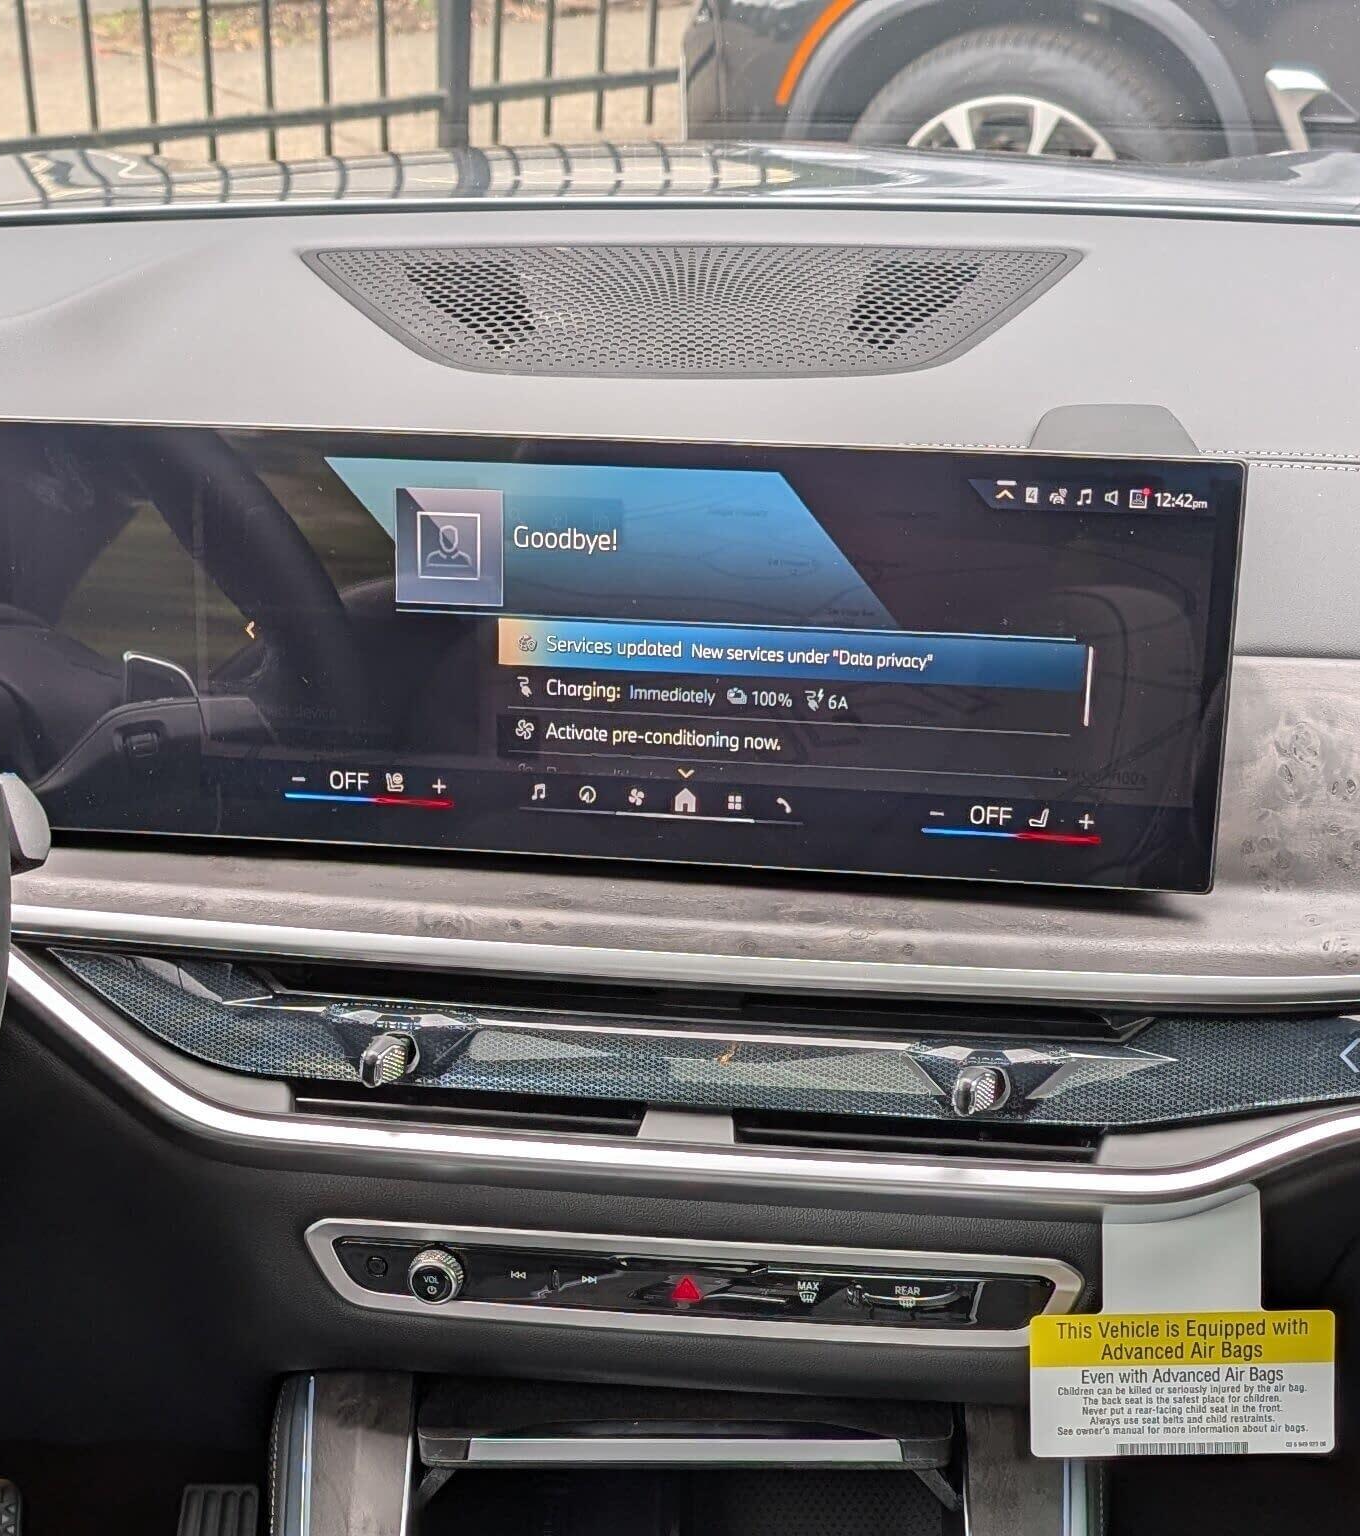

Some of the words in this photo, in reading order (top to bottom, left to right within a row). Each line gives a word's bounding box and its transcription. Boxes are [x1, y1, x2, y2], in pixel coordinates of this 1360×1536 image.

[513, 525, 619, 555] Goodbye!
[546, 635, 612, 655] Services
[617, 641, 682, 659] updated
[691, 644, 722, 660] New
[726, 647, 784, 661] services
[787, 648, 830, 664] under
[832, 650, 873, 667] "Data
[876, 653, 934, 671] privacy"
[546, 678, 621, 701] Charging:
[629, 684, 716, 706] Immediately
[751, 690, 793, 708] 100%
[828, 695, 849, 710] 6A
[545, 723, 608, 742] Activate
[612, 729, 740, 752] pre-conditioning
[744, 736, 781, 751] now.
[329, 771, 370, 792] OFF
[969, 805, 1013, 826] OFF
[797, 1281, 819, 1291] MAX
[894, 1285, 920, 1296] REAR
[1056, 1323, 1092, 1340] This
[1098, 1321, 1159, 1339] Vehicle
[1166, 1320, 1180, 1337] is
[1186, 1319, 1266, 1340] Equipped
[1272, 1318, 1309, 1335] with
[1100, 1343, 1184, 1361] Advanced
[1190, 1342, 1216, 1359] Air
[1221, 1341, 1263, 1361] Bags
[1081, 1369, 1114, 1385] Even
[1118, 1369, 1148, 1384] with
[1151, 1367, 1220, 1383] Advanced
[1224, 1367, 1245, 1382] Air
[1249, 1366, 1284, 1384] Bags
[1057, 1386, 1094, 1396] Children
[1115, 1386, 1126, 1395] be
[1128, 1385, 1152, 1394] killed
[1167, 1385, 1207, 1395] seriously
[1210, 1384, 1241, 1395] injured
[1243, 1384, 1254, 1395] by
[1257, 1384, 1271, 1393] the
[1274, 1384, 1286, 1392] air
[1288, 1384, 1308, 1394] bag.
[1083, 1397, 1099, 1405] The
[1101, 1396, 1122, 1405] back
[1124, 1396, 1143, 1405] seat
[1145, 1396, 1154, 1404] is
[1156, 1396, 1170, 1404] the
[1172, 1395, 1199, 1404] safest
[1202, 1395, 1225, 1405] place
[1228, 1394, 1241, 1403] for
[1243, 1393, 1282, 1403] children.
[1082, 1407, 1107, 1416] Never
[1110, 1407, 1125, 1417] put
[1135, 1405, 1183, 1416] rear-facing
[1185, 1405, 1207, 1414] child
[1209, 1405, 1228, 1413] seat
[1231, 1404, 1239, 1413] in
[1242, 1404, 1256, 1412] the
[1090, 1417, 1121, 1427] Always
[1123, 1417, 1139, 1425] use
[1142, 1416, 1161, 1425] seat
[1163, 1415, 1184, 1424] belts
[1186, 1415, 1203, 1424] and
[1205, 1414, 1227, 1423] child
[1230, 1413, 1276, 1423] restraints.
[1057, 1427, 1074, 1436] See
[1076, 1426, 1110, 1435] owner's
[1113, 1425, 1145, 1435] manual
[1147, 1425, 1161, 1434] for
[1163, 1426, 1186, 1434] more
[1188, 1424, 1240, 1433] information
[1242, 1423, 1268, 1432] about
[1270, 1423, 1282, 1432] air
[1284, 1423, 1309, 1433] bags.
